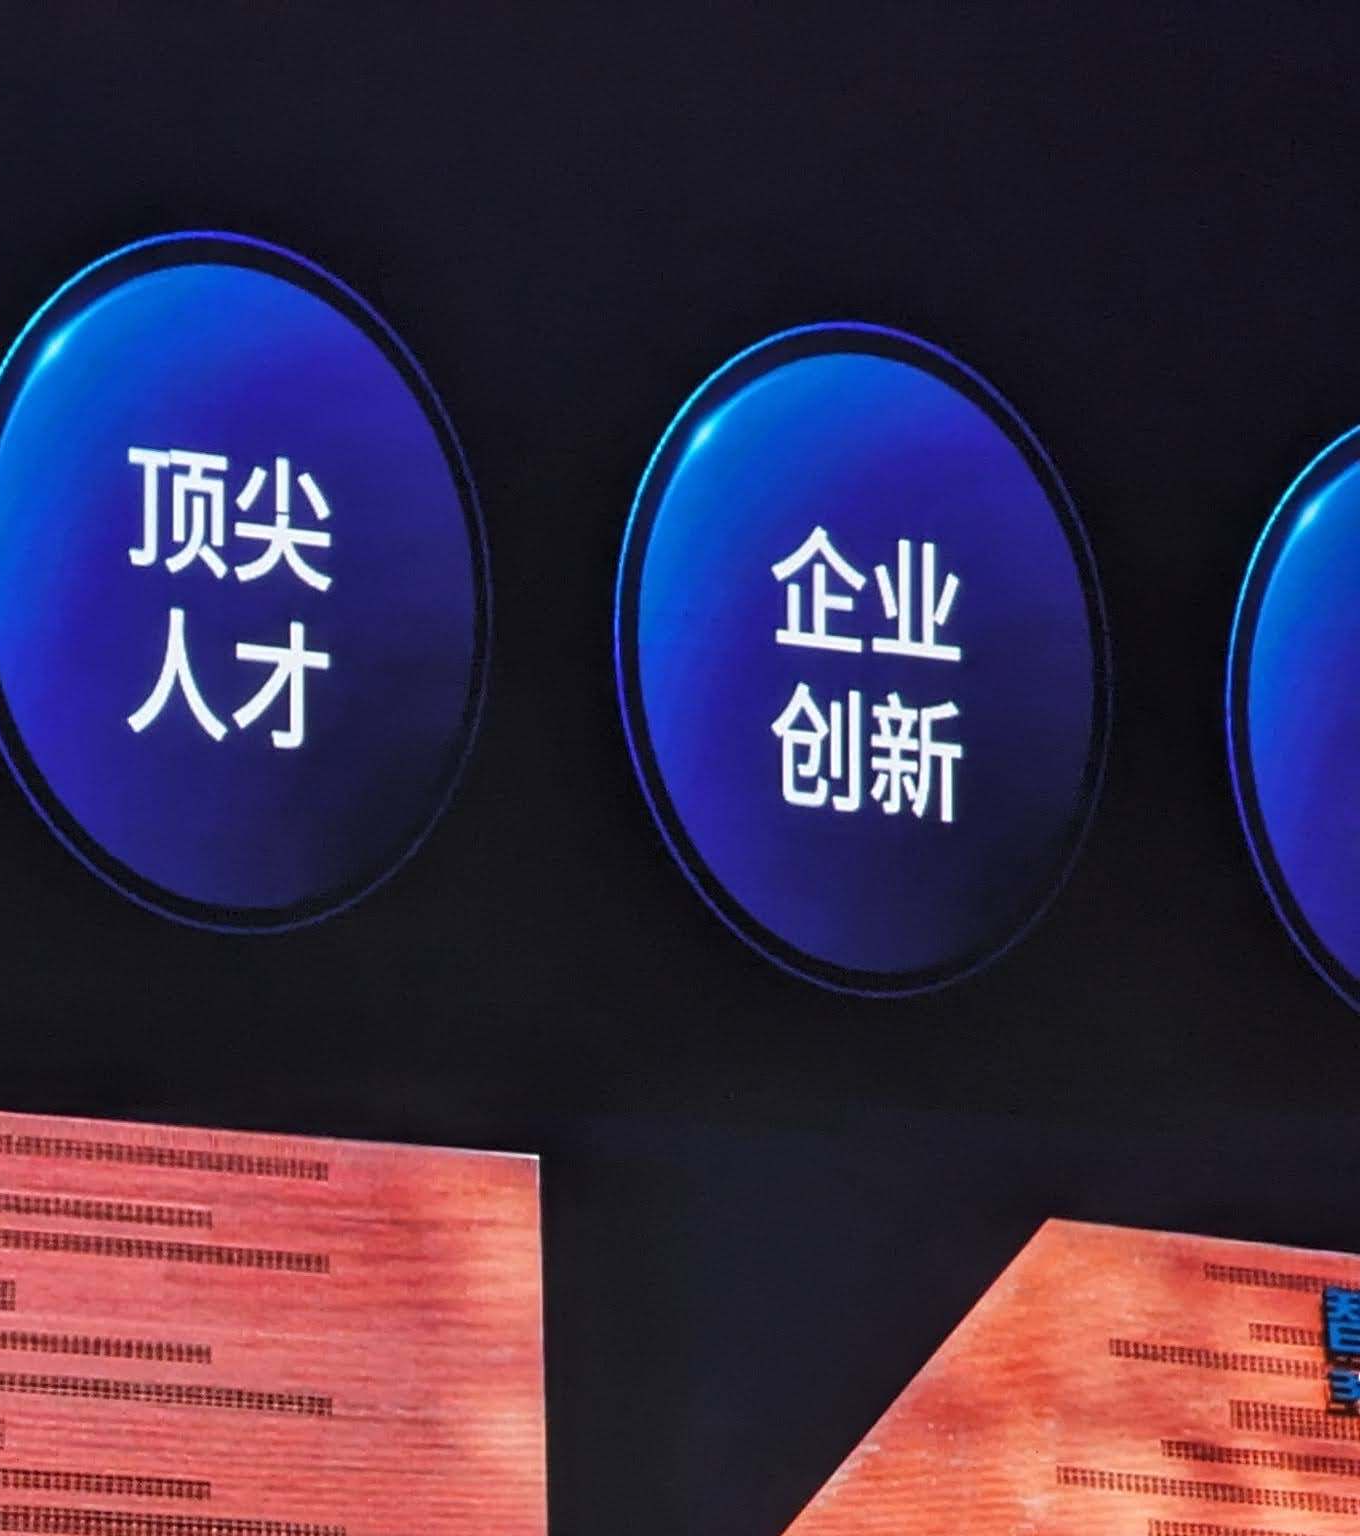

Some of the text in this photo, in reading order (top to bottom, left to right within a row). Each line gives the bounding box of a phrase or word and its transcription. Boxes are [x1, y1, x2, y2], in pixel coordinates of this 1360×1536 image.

[128, 448, 332, 592] 顶尖
[771, 526, 962, 662] 企业
[127, 608, 330, 750] 人才
[771, 682, 962, 826] 创新
